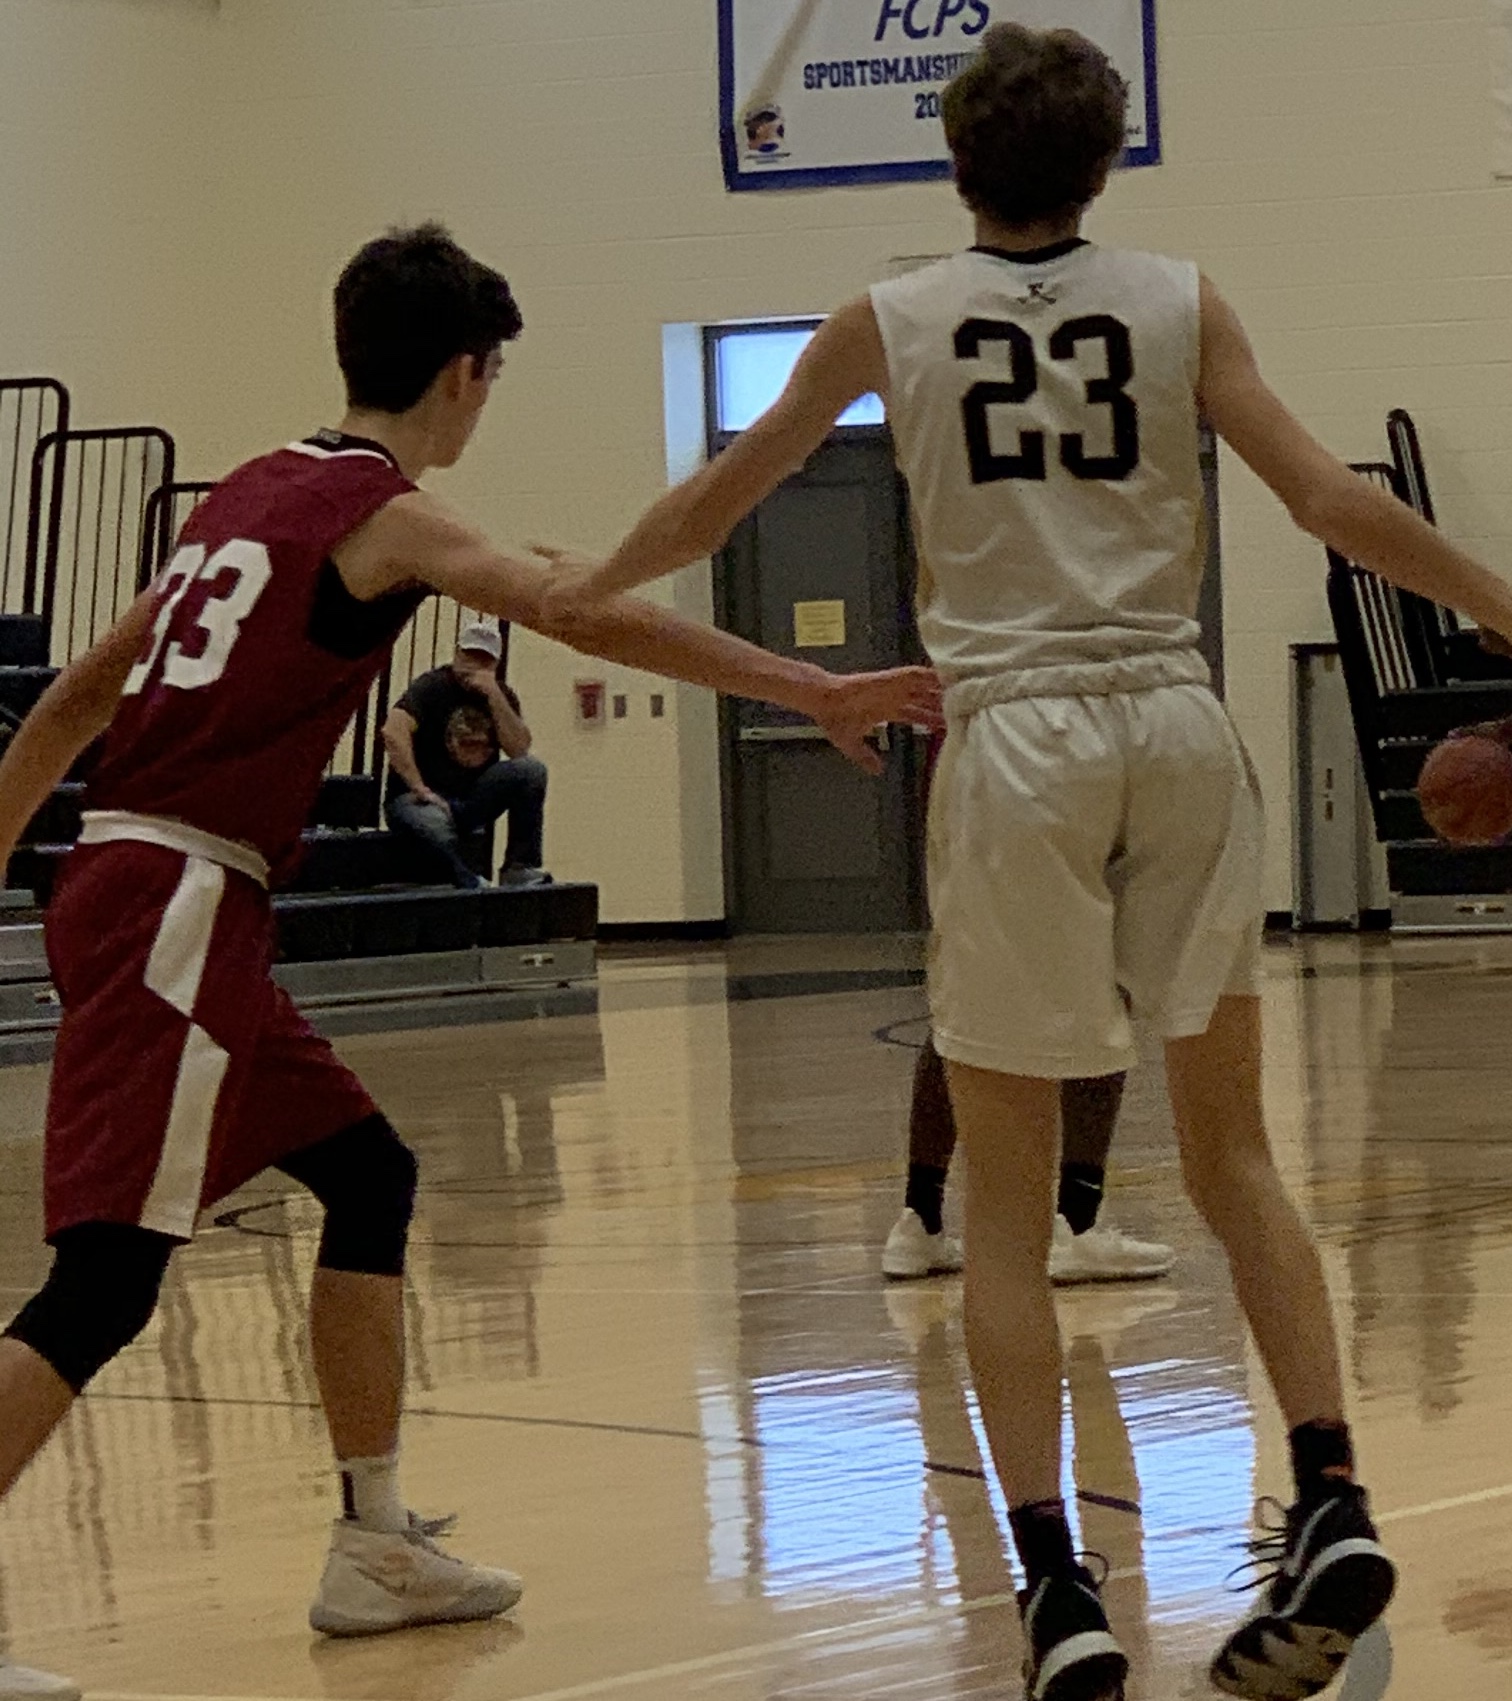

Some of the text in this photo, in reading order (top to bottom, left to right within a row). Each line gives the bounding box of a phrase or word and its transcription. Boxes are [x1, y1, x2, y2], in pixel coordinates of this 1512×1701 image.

[874, 0, 990, 41] FCPS
[803, 52, 974, 90] SPORTSMANSH
[953, 314, 1139, 484] 23
